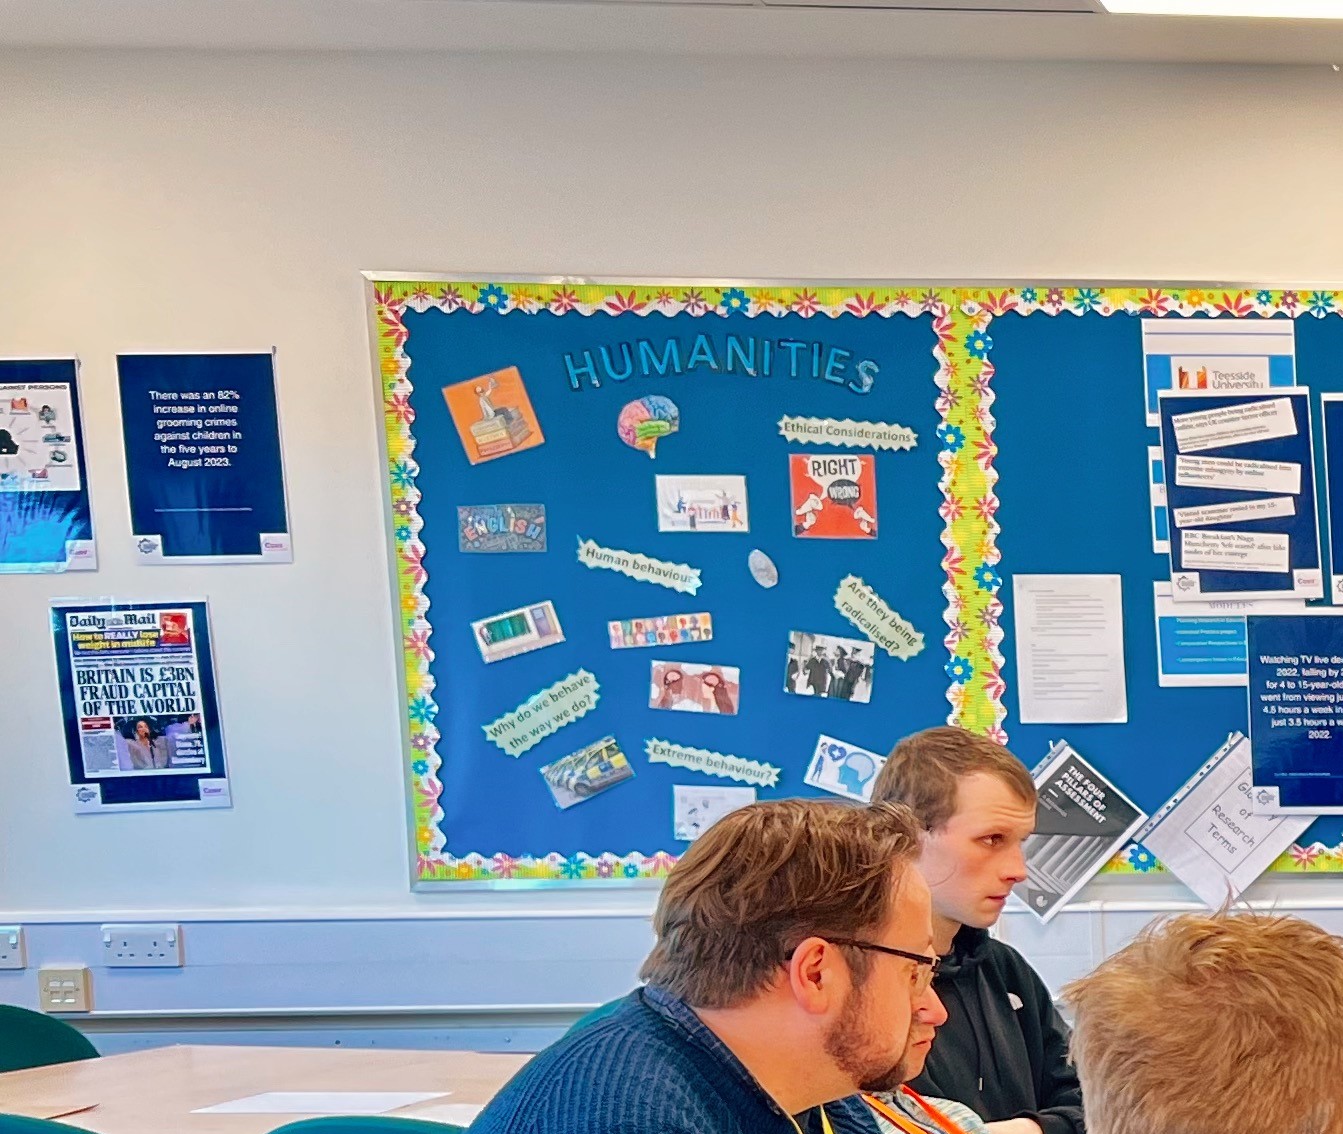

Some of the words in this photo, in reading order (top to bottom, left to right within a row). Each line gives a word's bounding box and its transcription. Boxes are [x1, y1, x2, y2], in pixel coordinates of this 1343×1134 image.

[563, 334, 879, 394] HUMANITIES
[1213, 370, 1256, 381] Teesside
[149, 390, 178, 400] There
[180, 392, 200, 400] was
[202, 392, 215, 400] an
[153, 404, 195, 414] increase
[197, 404, 206, 413] in
[208, 404, 238, 413] online
[156, 418, 203, 429] grooming
[204, 418, 237, 426] crimes
[784, 422, 822, 434] Ethical
[826, 425, 911, 442] Considerations
[154, 432, 190, 442] against
[192, 431, 230, 440] children
[232, 430, 242, 439] in
[160, 445, 176, 454] the
[178, 444, 196, 454] five
[198, 446, 226, 455] years
[227, 445, 238, 453] to
[168, 457, 202, 469] August
[204, 457, 232, 467] 2023.
[812, 459, 857, 477] RIGHT
[829, 485, 860, 499] WRONG
[464, 507, 542, 541] ENGLISH
[586, 547, 629, 567] Human
[632, 559, 692, 583] behaviour
[70, 615, 106, 629] Daily
[123, 613, 156, 625] Mail
[848, 582, 866, 600] Are
[866, 598, 890, 621] they
[889, 618, 917, 646] being
[841, 601, 900, 652] radicalised?
[1260, 655, 1299, 665] Watching
[1300, 655, 1313, 664] TV
[1314, 655, 1329, 664] live
[76, 668, 135, 685] BRITAIN
[140, 667, 154, 682] IS
[159, 666, 195, 681] £3BN
[1328, 668, 1339, 678] by
[80, 685, 129, 700] FRAUD
[134, 681, 195, 698] CAPITAL
[1266, 680, 1277, 689] for
[1280, 681, 1285, 689] 4
[1287, 681, 1295, 689] to
[83, 702, 102, 716] OF
[105, 700, 137, 715] THE
[140, 698, 195, 714] WORLD
[489, 720, 516, 738] Why
[517, 710, 531, 723] do
[532, 699, 550, 713] we
[549, 676, 591, 703] behave
[1282, 693, 1301, 701] from
[1303, 693, 1335, 703] viewing
[1278, 706, 1302, 714] hours
[1311, 706, 1333, 714] week
[1335, 706, 1343, 714] in
[509, 734, 529, 749] the
[529, 720, 552, 737] way
[553, 709, 570, 722] we
[571, 694, 592, 713] do?
[1303, 718, 1327, 726] hours
[1308, 730, 1332, 739] 2022.
[653, 744, 703, 763] Extreme
[706, 756, 772, 780] behaviour?
[1061, 772, 1094, 801] PILLARS
[1093, 800, 1107, 811] OF
[1068, 765, 1084, 781] THE
[1082, 779, 1106, 800] FOUR
[1054, 779, 1106, 823] ASSESSMENT
[1239, 808, 1253, 820] of
[1212, 804, 1255, 847] Research
[1207, 822, 1237, 854] Terms
